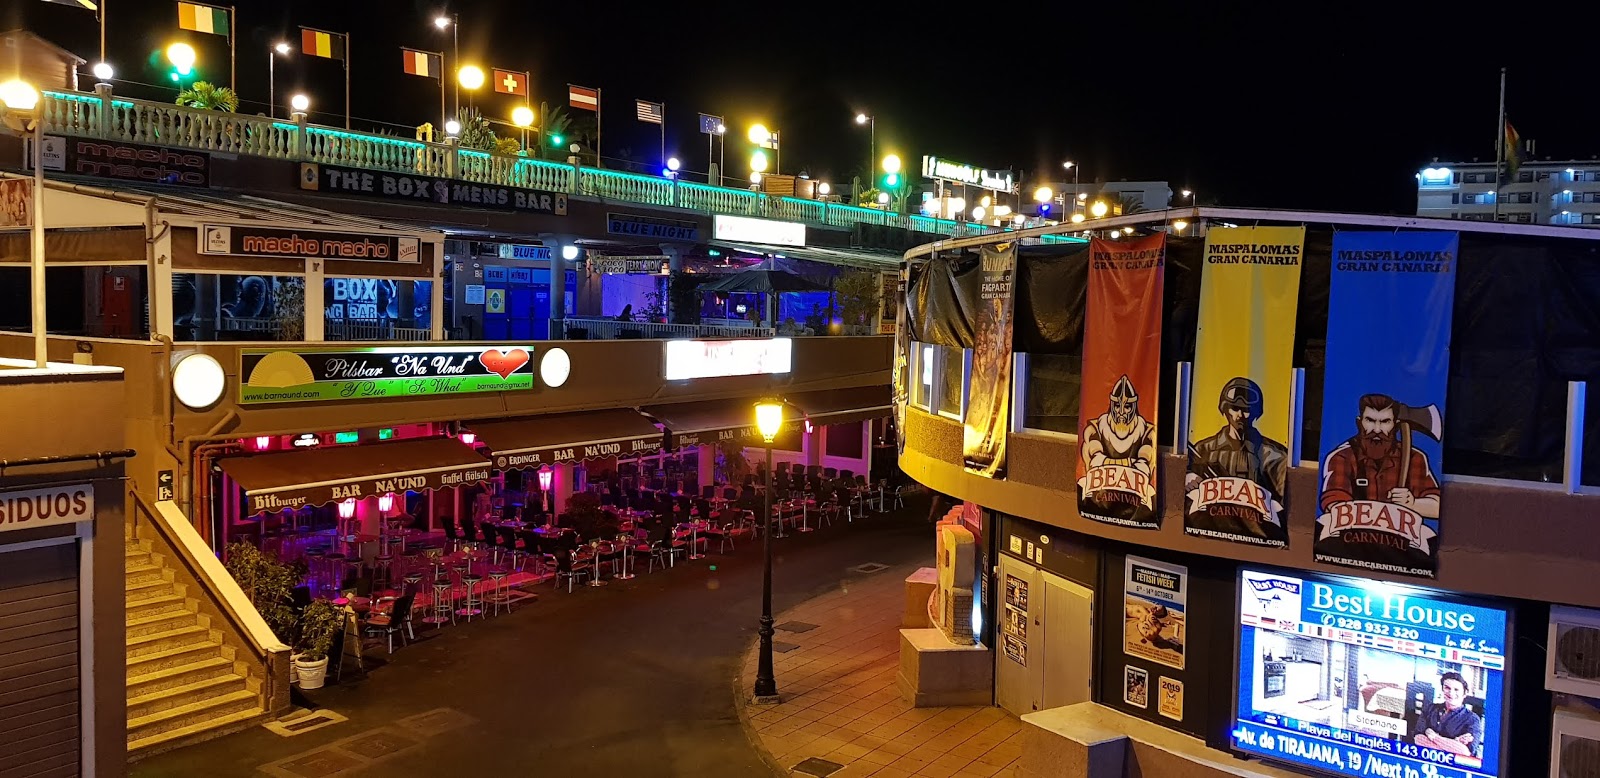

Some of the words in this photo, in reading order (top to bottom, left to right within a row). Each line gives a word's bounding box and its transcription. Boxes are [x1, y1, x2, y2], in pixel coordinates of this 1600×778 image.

[77, 142, 205, 167] macho
[76, 160, 205, 184] macho
[326, 168, 374, 192] THE
[382, 175, 430, 198] BOX
[452, 184, 508, 205] MENS
[513, 191, 552, 211] BAR
[613, 221, 649, 235] BLUE
[652, 224, 695, 240] NIGHT
[243, 234, 319, 255] macho
[322, 238, 389, 258] macho
[513, 247, 535, 258] BLUE
[1094, 248, 1165, 261] MASPALOMAS
[1208, 244, 1300, 255] MASPALOMAS
[1336, 250, 1452, 262] MASPALOMAS
[1093, 260, 1123, 270] GRAN
[1208, 255, 1240, 264] GRAN
[1241, 255, 1299, 265] CANARIA
[1336, 262, 1379, 272] GRAN
[1381, 263, 1450, 273] CANARIA
[334, 279, 377, 300] BOX
[348, 304, 377, 318] BAR
[325, 358, 384, 378] Pilsbar
[244, 391, 320, 400] www.barnaund.com
[477, 382, 530, 391] barnaund@gmx.net
[719, 430, 734, 441] BAR
[509, 454, 541, 466] ERDINGER
[554, 448, 575, 461] BAR
[584, 443, 621, 457] NA'UND
[631, 440, 661, 451] Bitburger
[254, 494, 307, 510] Bitburger
[331, 484, 362, 500] BAR
[375, 476, 427, 493] NA'UND
[441, 471, 463, 485] Gaffel
[465, 469, 489, 481] Kölsch
[1089, 466, 1147, 497] BEAR
[1095, 490, 1141, 507] CARNIVAL
[1202, 479, 1271, 514] BEAR
[1080, 511, 1159, 528] WWW.BEARCARNIVAL.COM
[1209, 505, 1263, 524] CARNIVAL
[1334, 502, 1419, 539] BEAR
[1185, 526, 1285, 546] WWW.BEARCARNIVAL.COM
[1343, 531, 1407, 551] CARNIVAL
[1315, 553, 1434, 577] WWW.BEARCARNIVAL.COM
[1136, 572, 1156, 585] FETISH
[1156, 577, 1175, 589] WEEK
[1311, 583, 1373, 616] Best
[1381, 594, 1476, 632] House
[1337, 617, 1362, 630] 928
[1364, 621, 1390, 635] 932
[1393, 625, 1419, 640] 320
[1162, 681, 1181, 693] 2019
[1239, 726, 1257, 746] Av.
[1259, 731, 1275, 750] de
[1277, 734, 1345, 770] TIRAJANA,
[1347, 751, 1362, 771] 19
[1297, 721, 1331, 738] Playa
[1333, 728, 1352, 742] del
[1355, 733, 1391, 751] Inglés
[1396, 742, 1418, 757] 143
[1421, 748, 1455, 765] 000€
